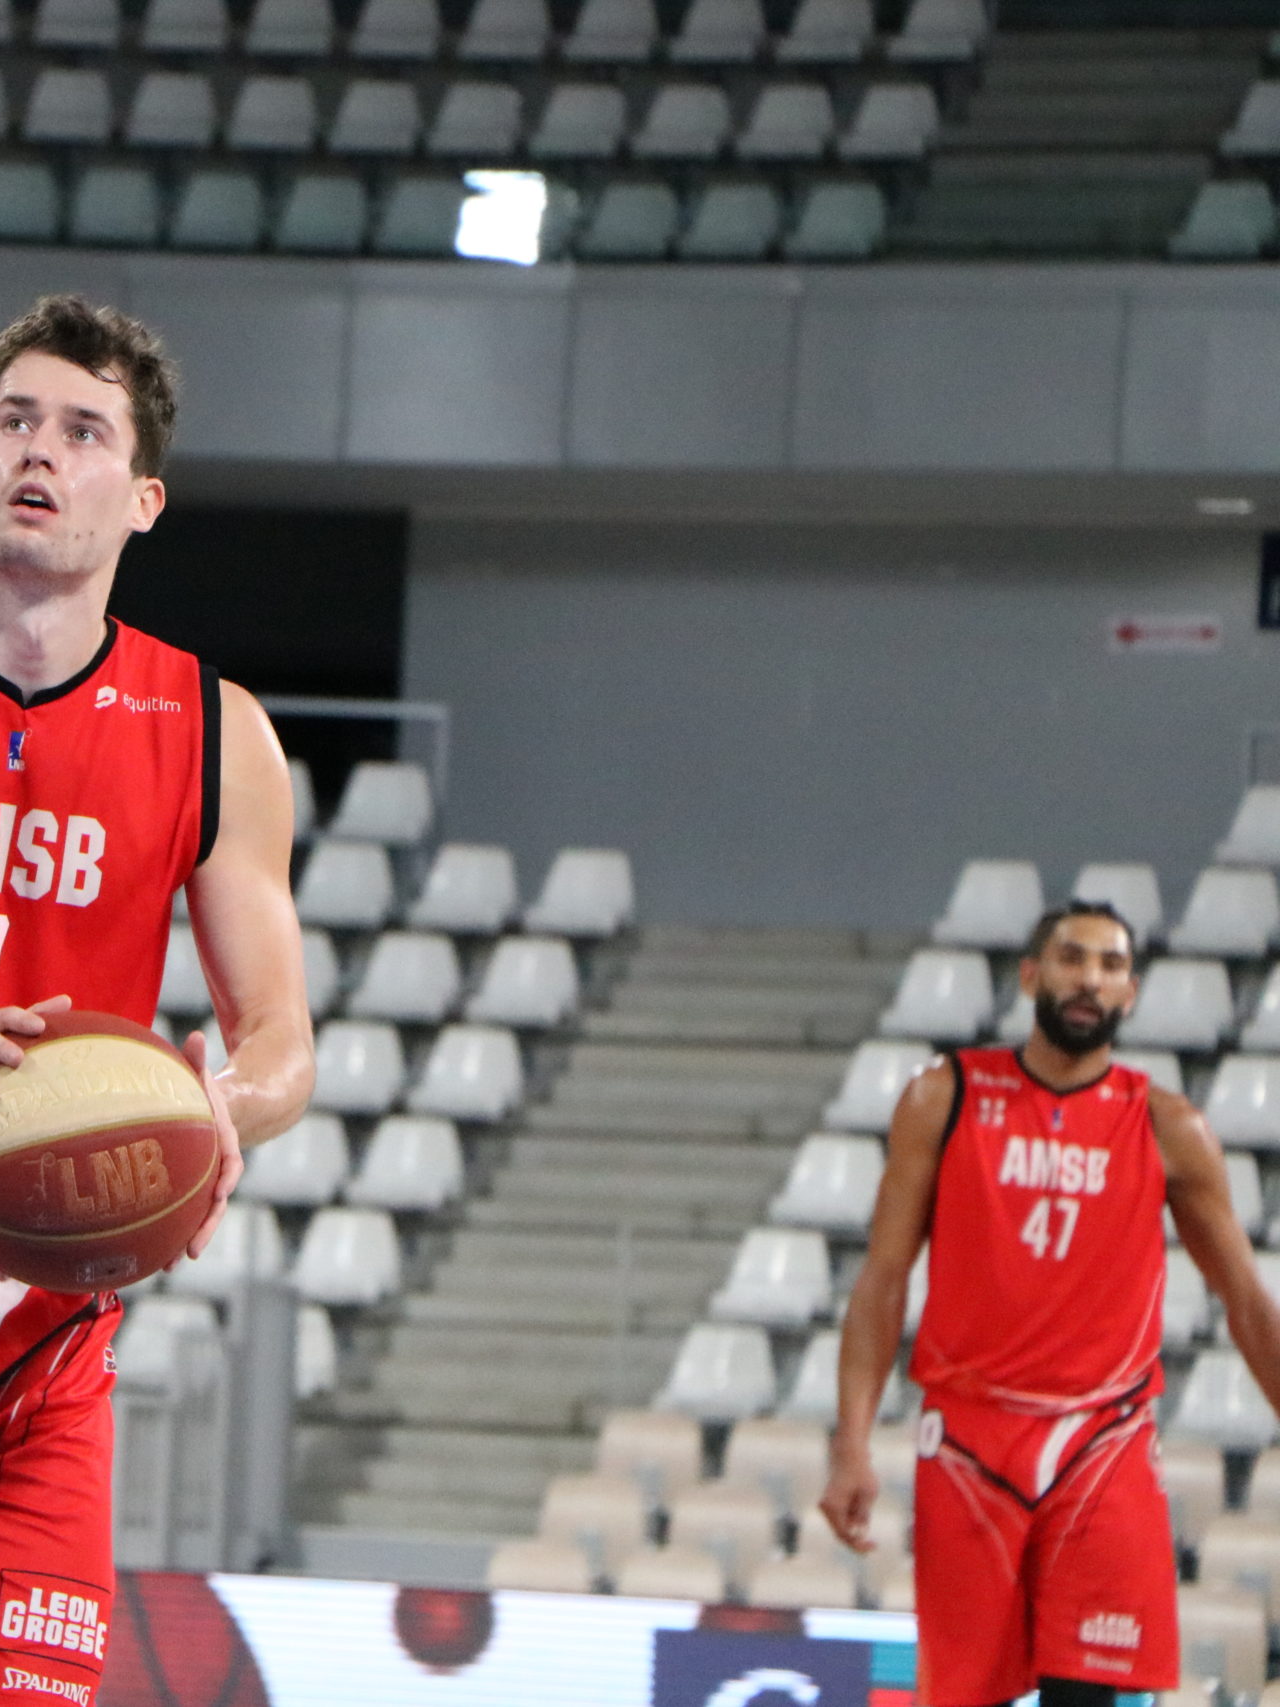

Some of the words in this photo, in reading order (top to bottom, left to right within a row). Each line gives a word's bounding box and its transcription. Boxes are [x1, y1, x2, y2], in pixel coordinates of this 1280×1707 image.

[123, 693, 181, 714] equitim
[57, 1138, 170, 1217] LNB
[997, 1135, 1111, 1196] AMSB
[1020, 1196, 1081, 1261] 47
[1, 1600, 108, 1661] GROSSE
[29, 1587, 99, 1627] LEON
[2, 1667, 92, 1707] SPALDING
